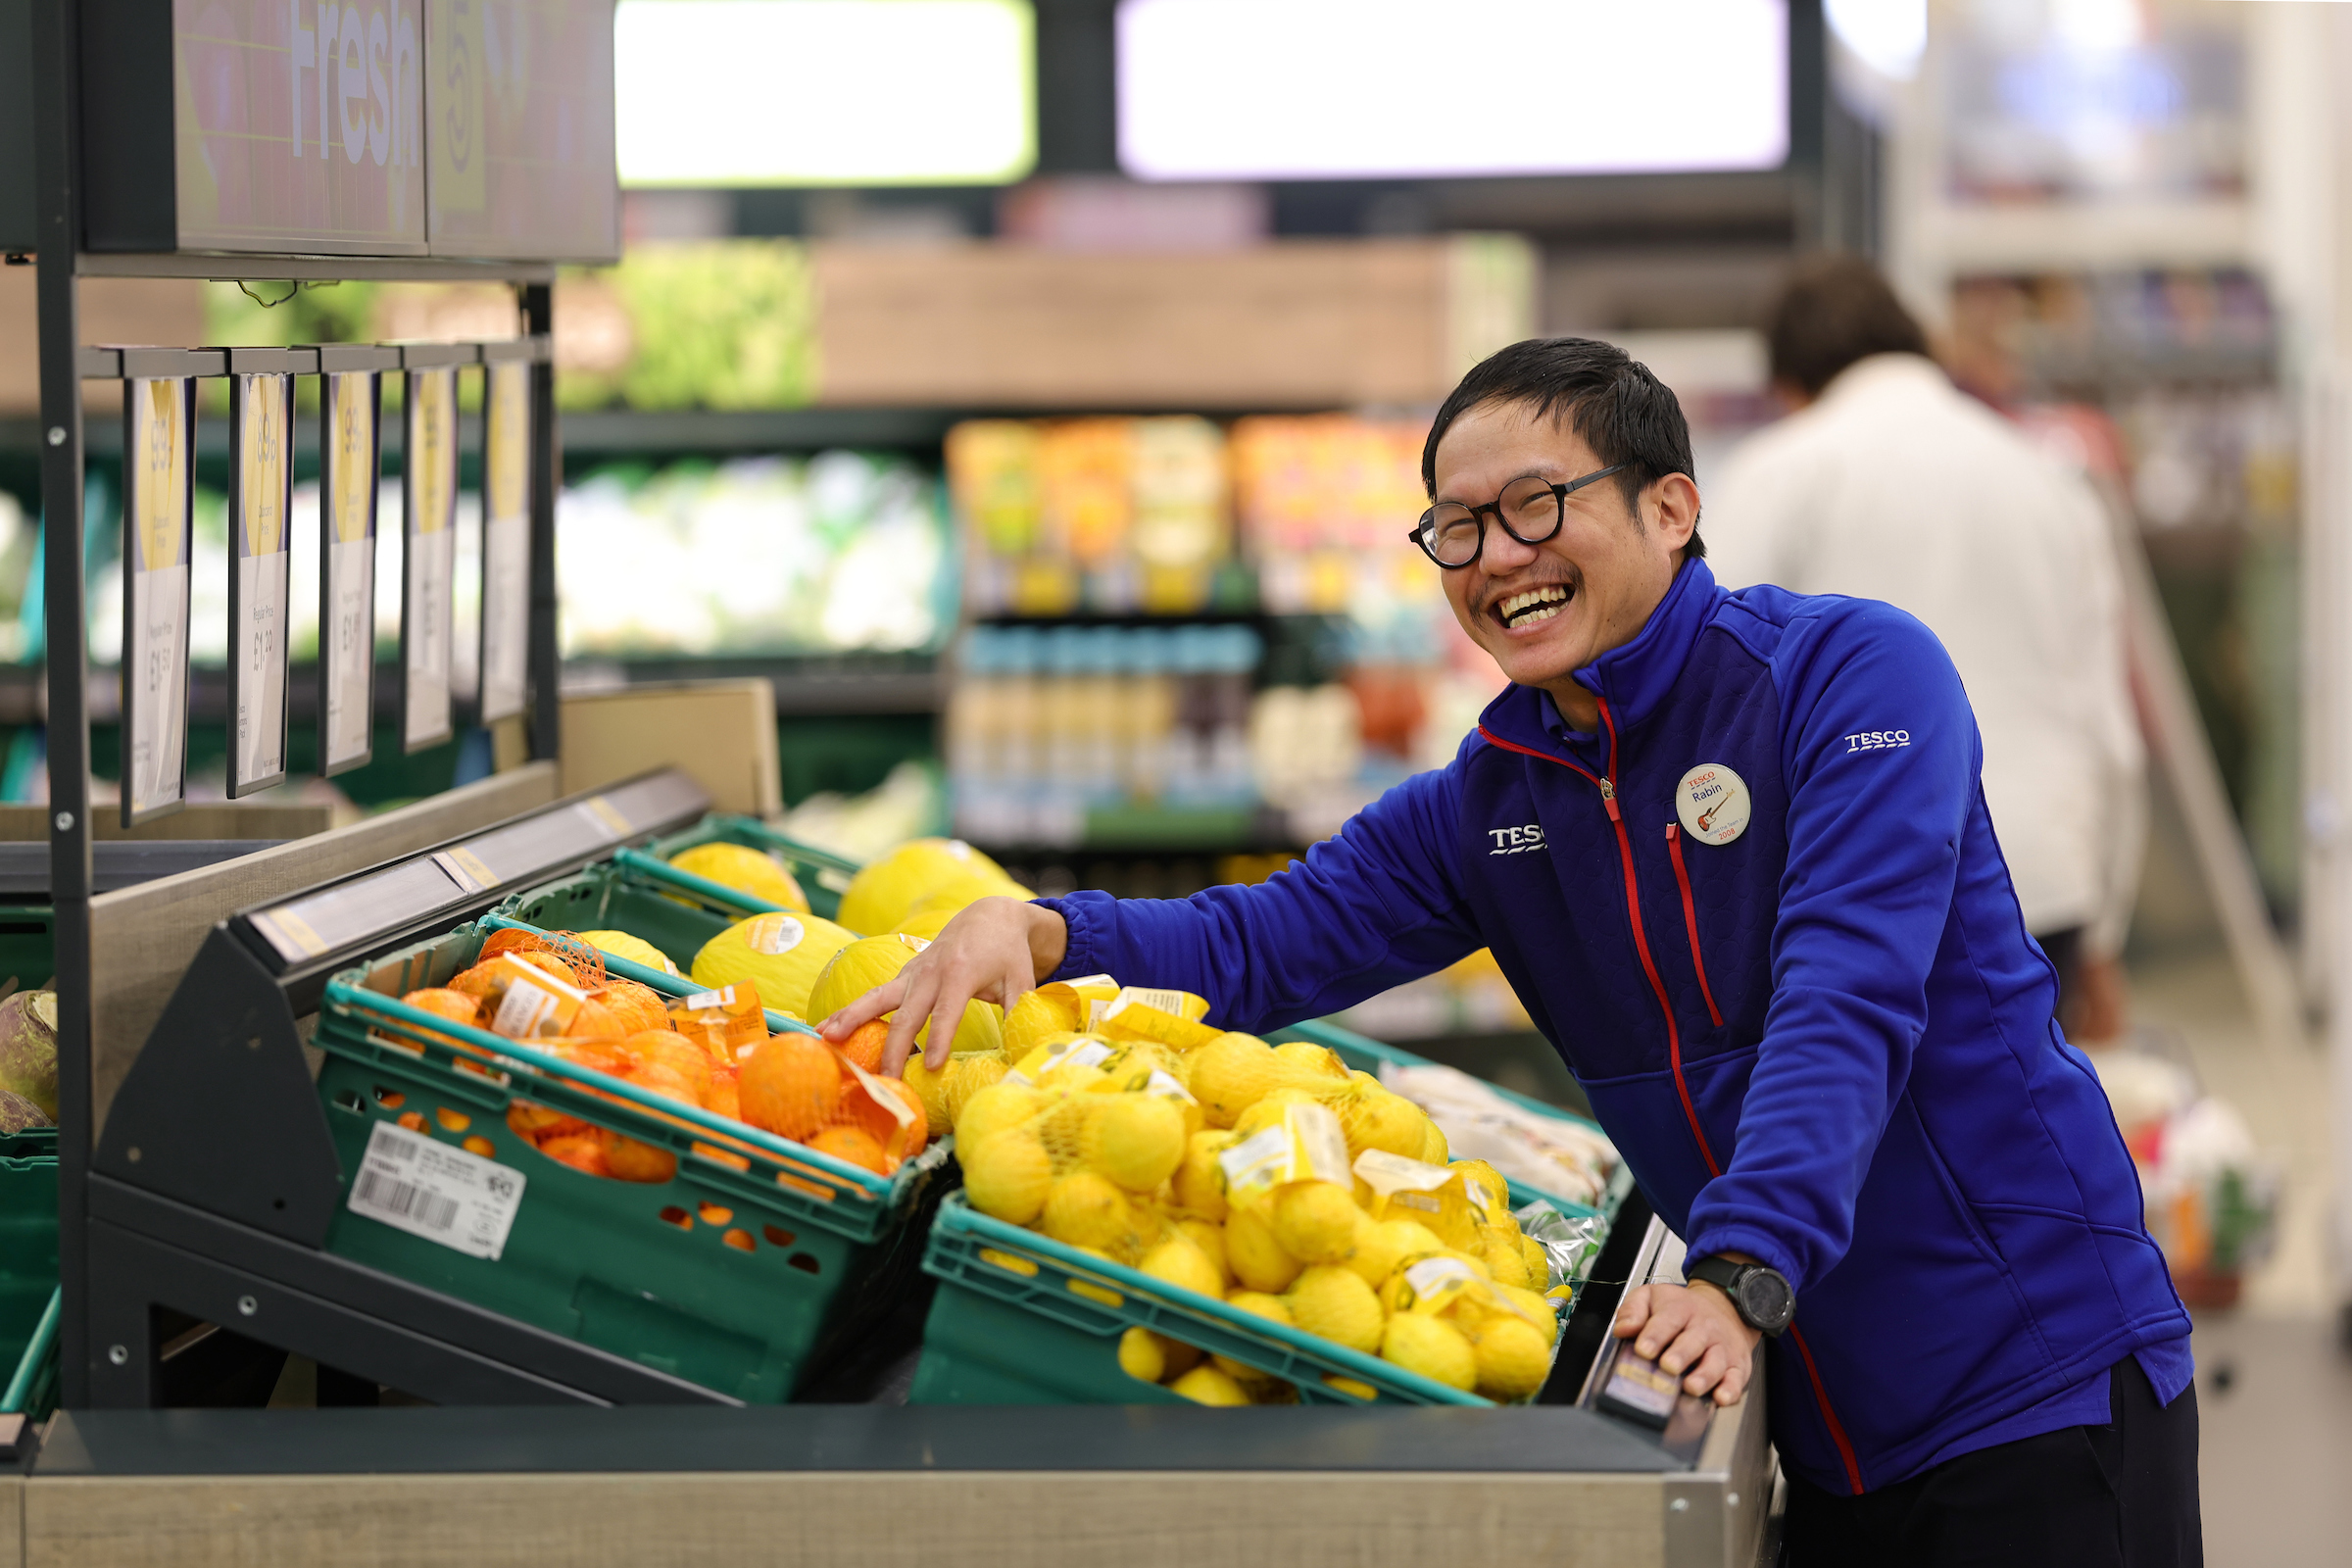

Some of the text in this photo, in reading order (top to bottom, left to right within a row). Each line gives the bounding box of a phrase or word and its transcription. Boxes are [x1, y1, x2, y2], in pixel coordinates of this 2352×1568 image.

[290, 0, 418, 167] Fresh
[257, 413, 276, 468] 89p
[1844, 729, 1910, 748] TESCO
[1688, 771, 1715, 787] TESCO
[1691, 784, 1723, 803] Rabin
[1488, 824, 1545, 848] TES
[1706, 828, 1720, 838] Joined
[1718, 827, 1736, 841] 2008
